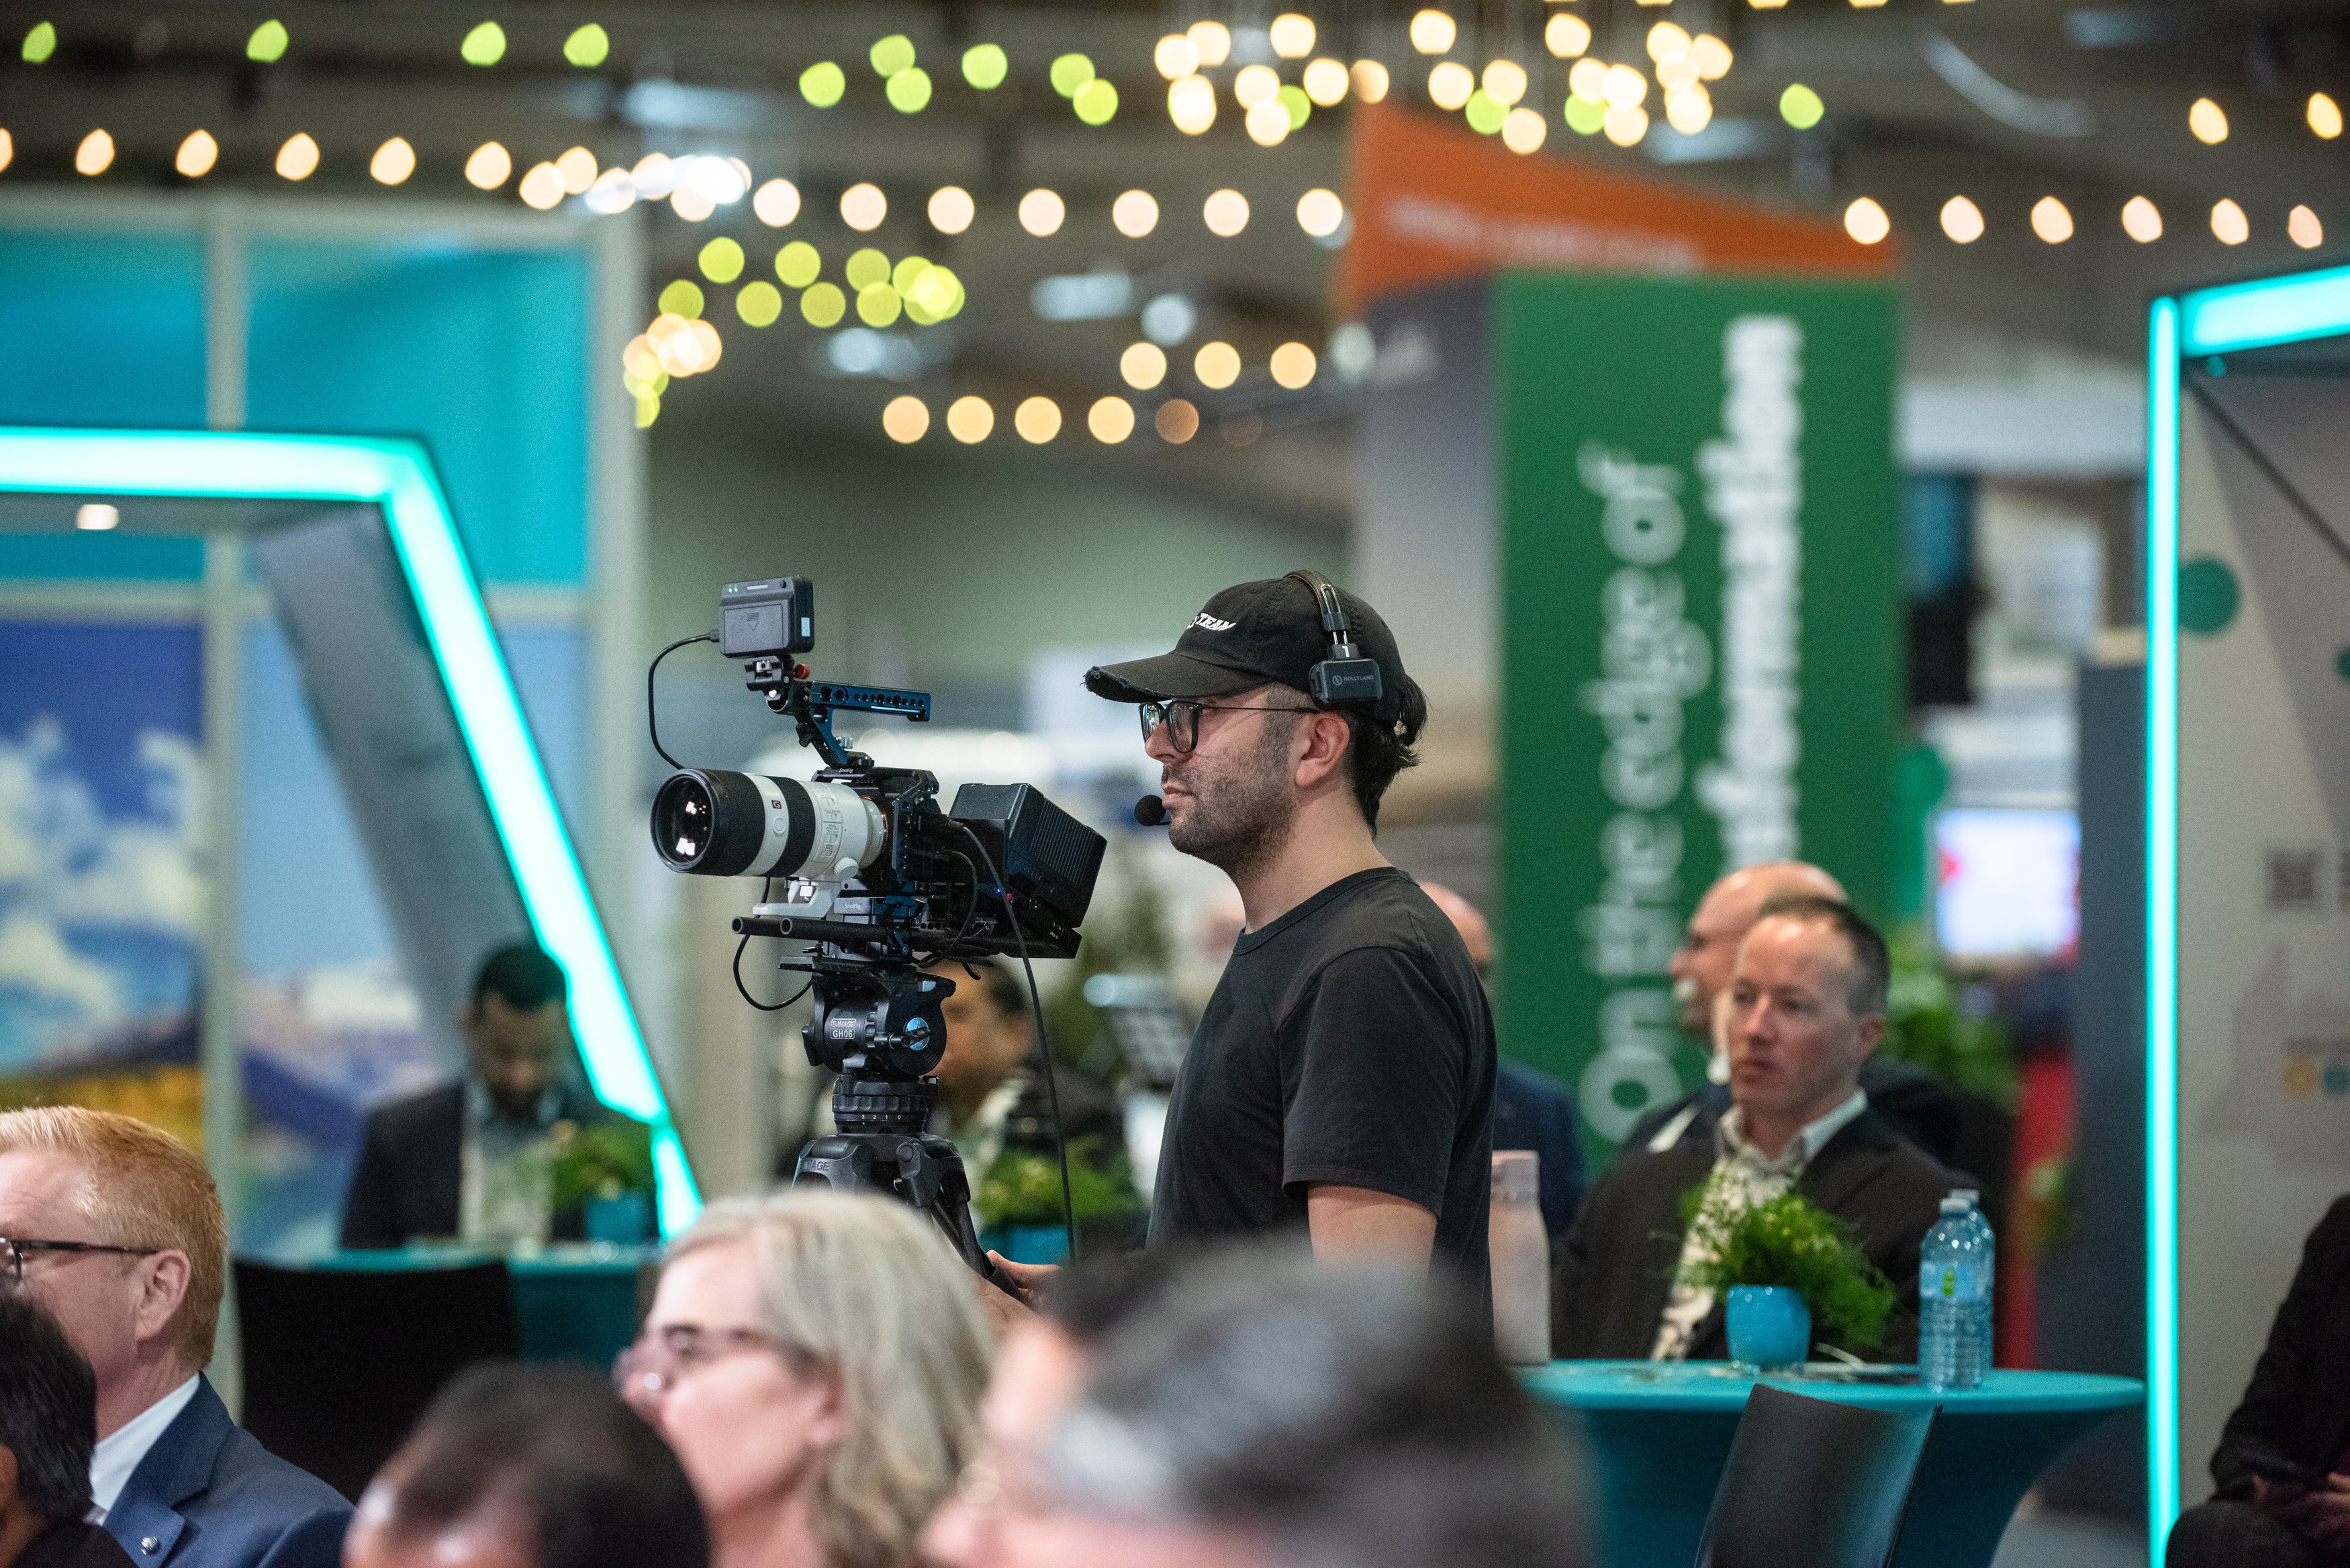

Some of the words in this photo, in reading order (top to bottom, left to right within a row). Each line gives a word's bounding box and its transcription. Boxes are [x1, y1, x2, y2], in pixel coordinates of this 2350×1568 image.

[1577, 439, 1686, 563] of
[1342, 645, 1350, 658] 1
[1577, 567, 1712, 807] edge
[1577, 814, 1682, 975] the
[833, 1030, 853, 1038] GH06
[1578, 989, 1682, 1141] On
